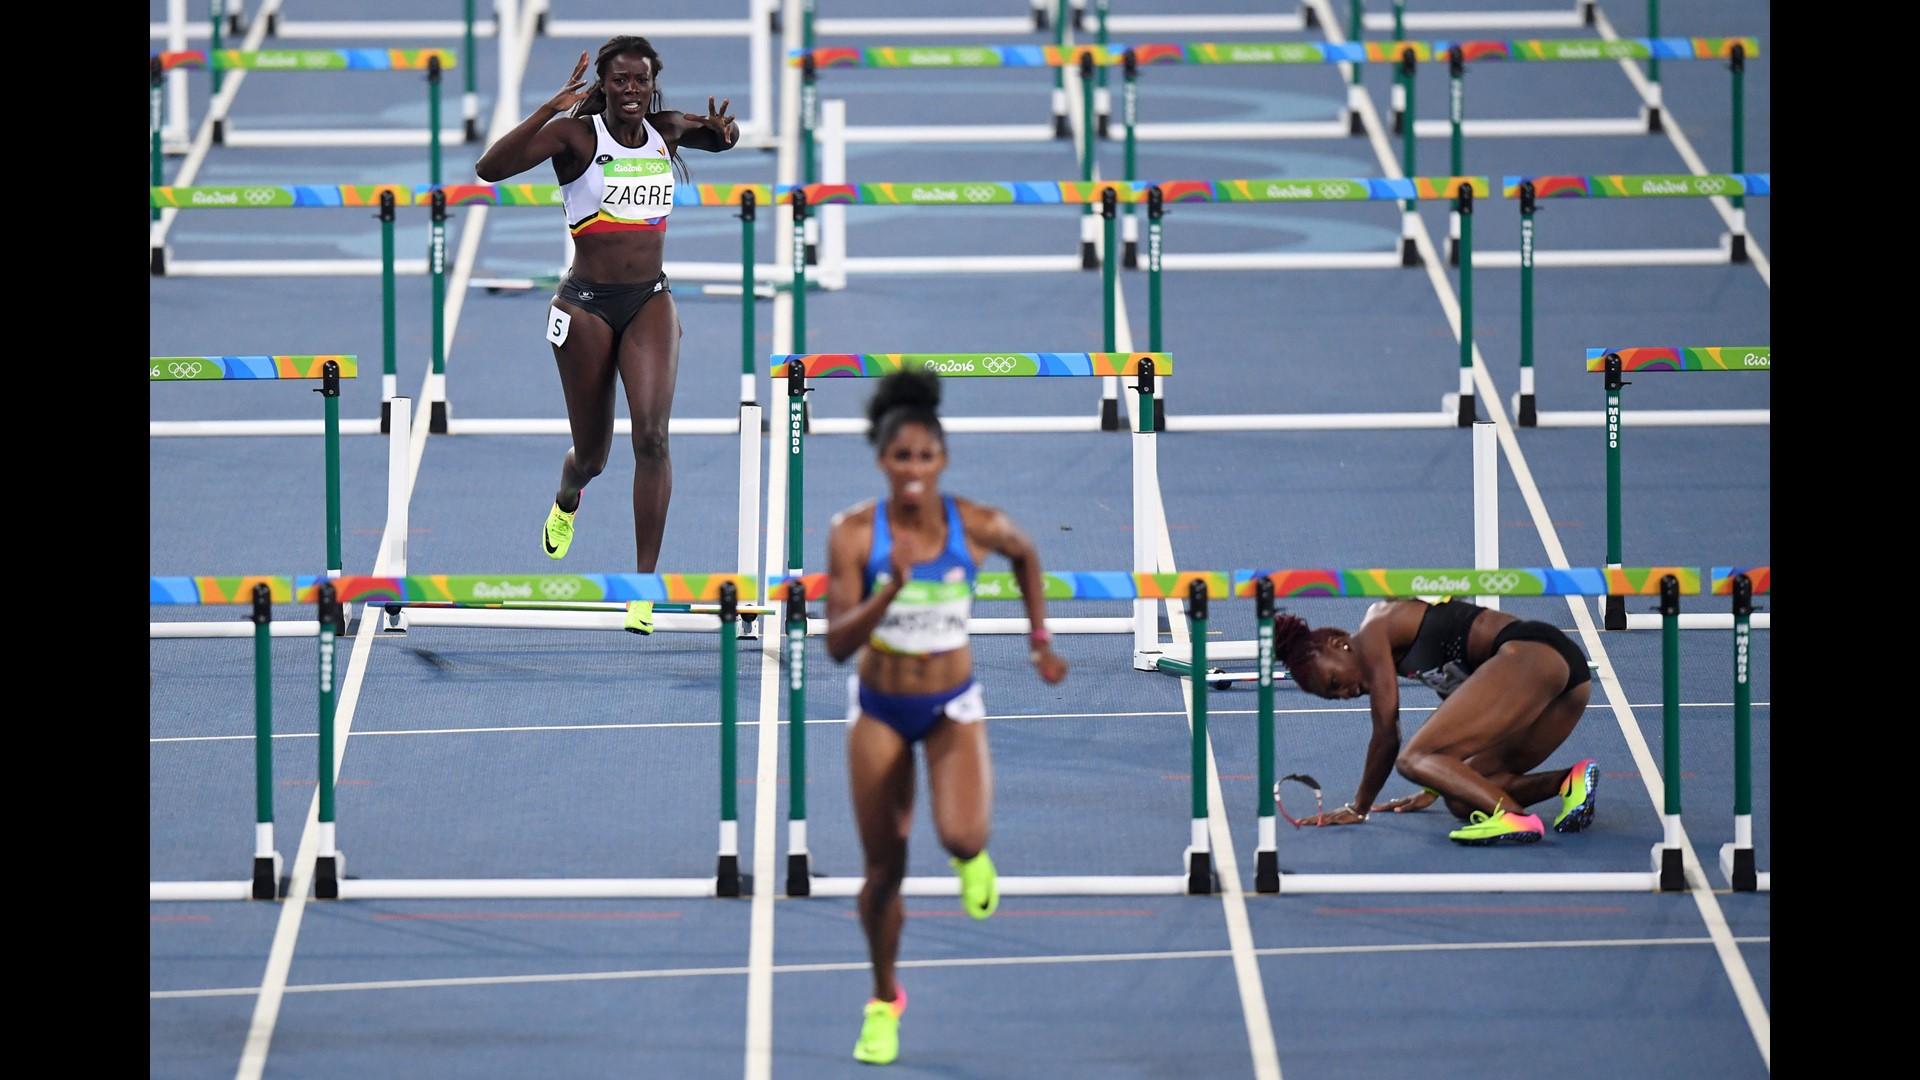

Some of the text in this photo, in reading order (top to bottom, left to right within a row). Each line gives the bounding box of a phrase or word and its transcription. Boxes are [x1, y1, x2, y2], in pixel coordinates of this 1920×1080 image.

[602, 184, 673, 206] ZAGRE
[791, 413, 802, 455] MONDO
[1608, 407, 1619, 449] MONDO
[1411, 574, 1471, 593] Rio2016
